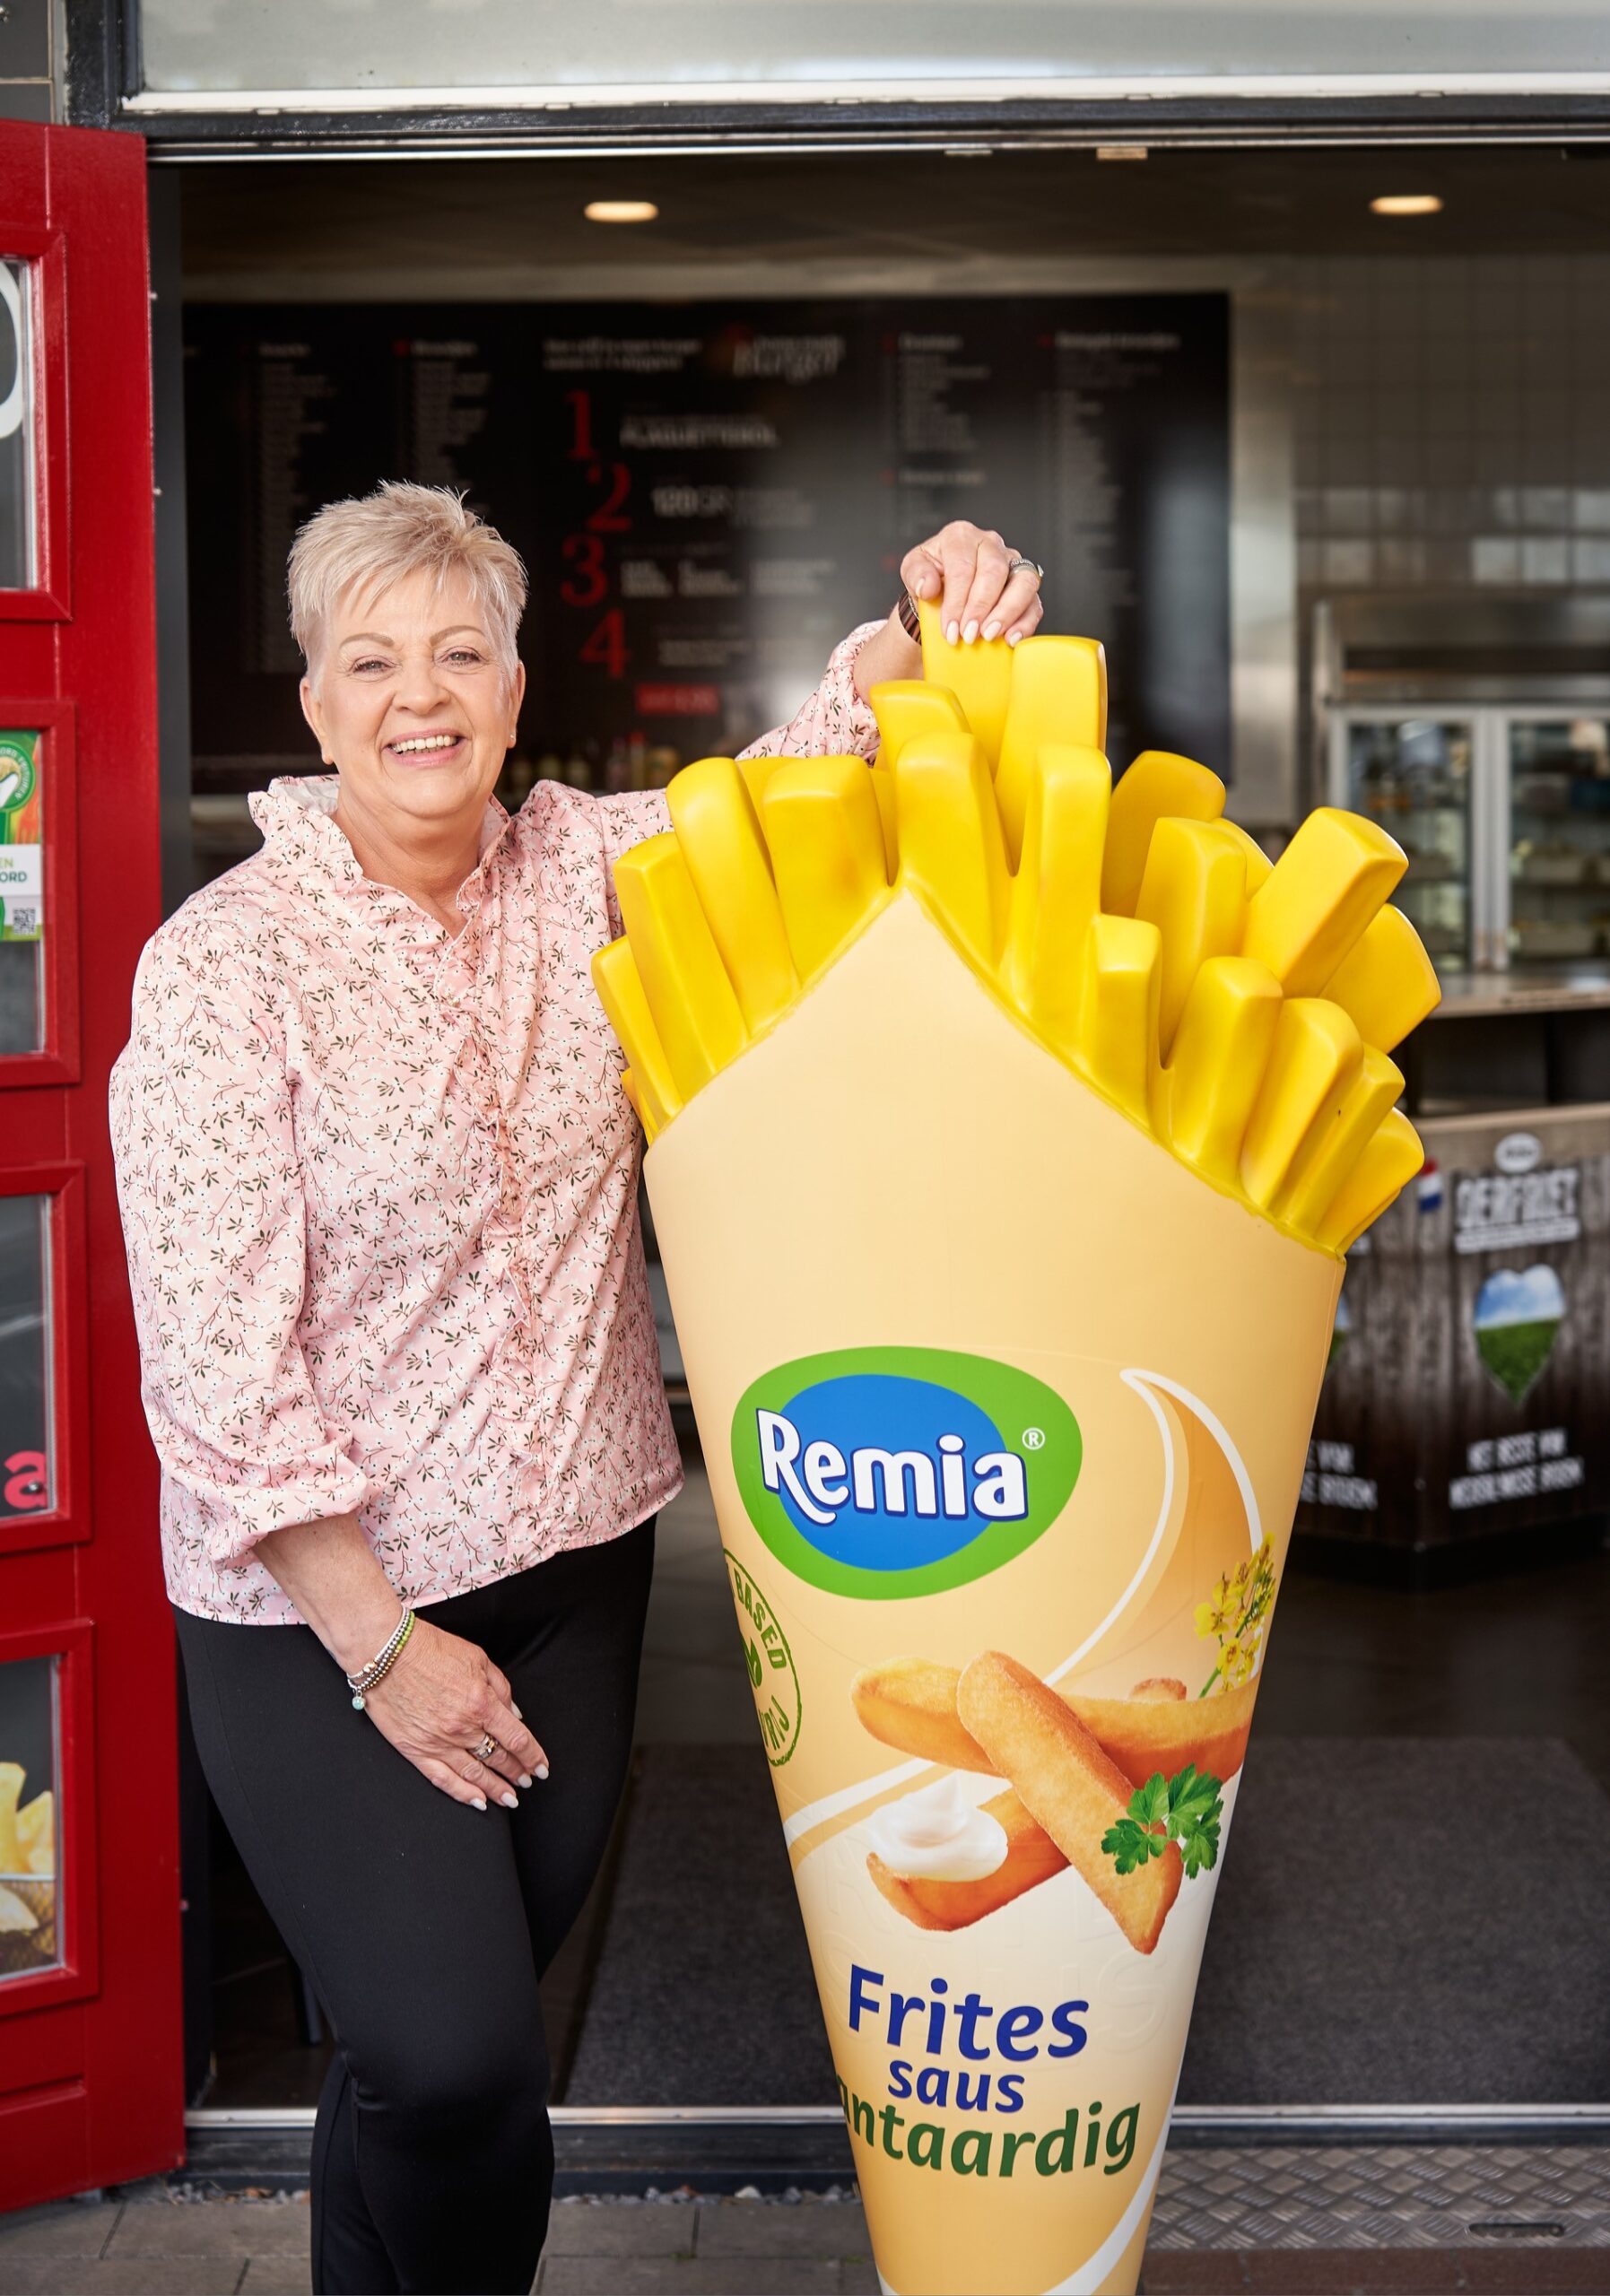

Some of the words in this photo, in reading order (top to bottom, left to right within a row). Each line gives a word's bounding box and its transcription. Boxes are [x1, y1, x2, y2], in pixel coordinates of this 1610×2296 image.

[564, 389, 597, 460] 1
[586, 462, 633, 532] 2
[561, 534, 607, 607] 3
[579, 608, 632, 679] 4
[756, 1408, 1029, 1526] Remia
[734, 1567, 788, 1669] BASED
[849, 1963, 1089, 2061] Frites
[888, 2059, 1025, 2113] saus
